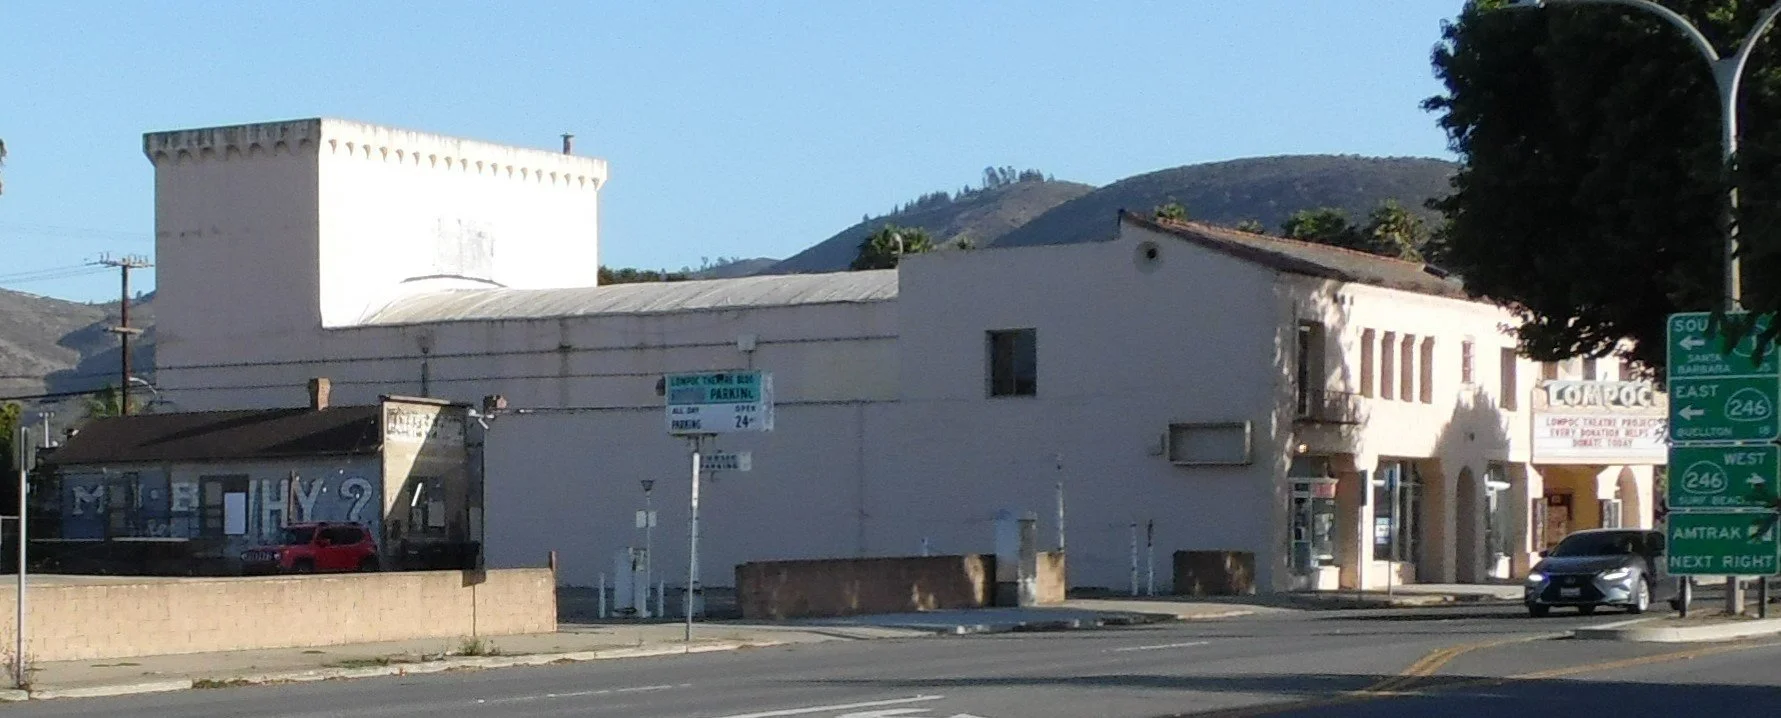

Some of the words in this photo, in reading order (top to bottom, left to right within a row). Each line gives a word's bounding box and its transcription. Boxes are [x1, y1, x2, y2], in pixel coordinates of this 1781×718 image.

[1675, 319, 1719, 333] SOU
[1687, 353, 1722, 363] SANTA
[1677, 364, 1731, 374] BARBARA
[671, 375, 699, 387] LOMPOC
[1548, 383, 1654, 408] LOMPOC
[1675, 385, 1719, 398] EAST
[671, 407, 684, 415] ALL
[735, 404, 756, 412] OPEN
[1729, 400, 1767, 416] 246
[671, 419, 702, 430] PARKING
[1546, 417, 1580, 427] LOMPOC
[1583, 417, 1617, 427] THEATRE
[1550, 428, 1576, 437] EVERY
[1580, 428, 1620, 437] DONATION
[1676, 428, 1733, 437] BUELLTON
[1572, 438, 1603, 448] DONATE
[1607, 438, 1633, 448] TODAY
[1723, 452, 1766, 466] WEST
[1686, 471, 1723, 488] 246
[1678, 496, 1705, 505] SURF
[1711, 495, 1746, 505] BEAC
[1672, 526, 1741, 540] AMTRAK
[1670, 554, 1714, 568] NEXT
[1722, 554, 1774, 568] RIGHT
